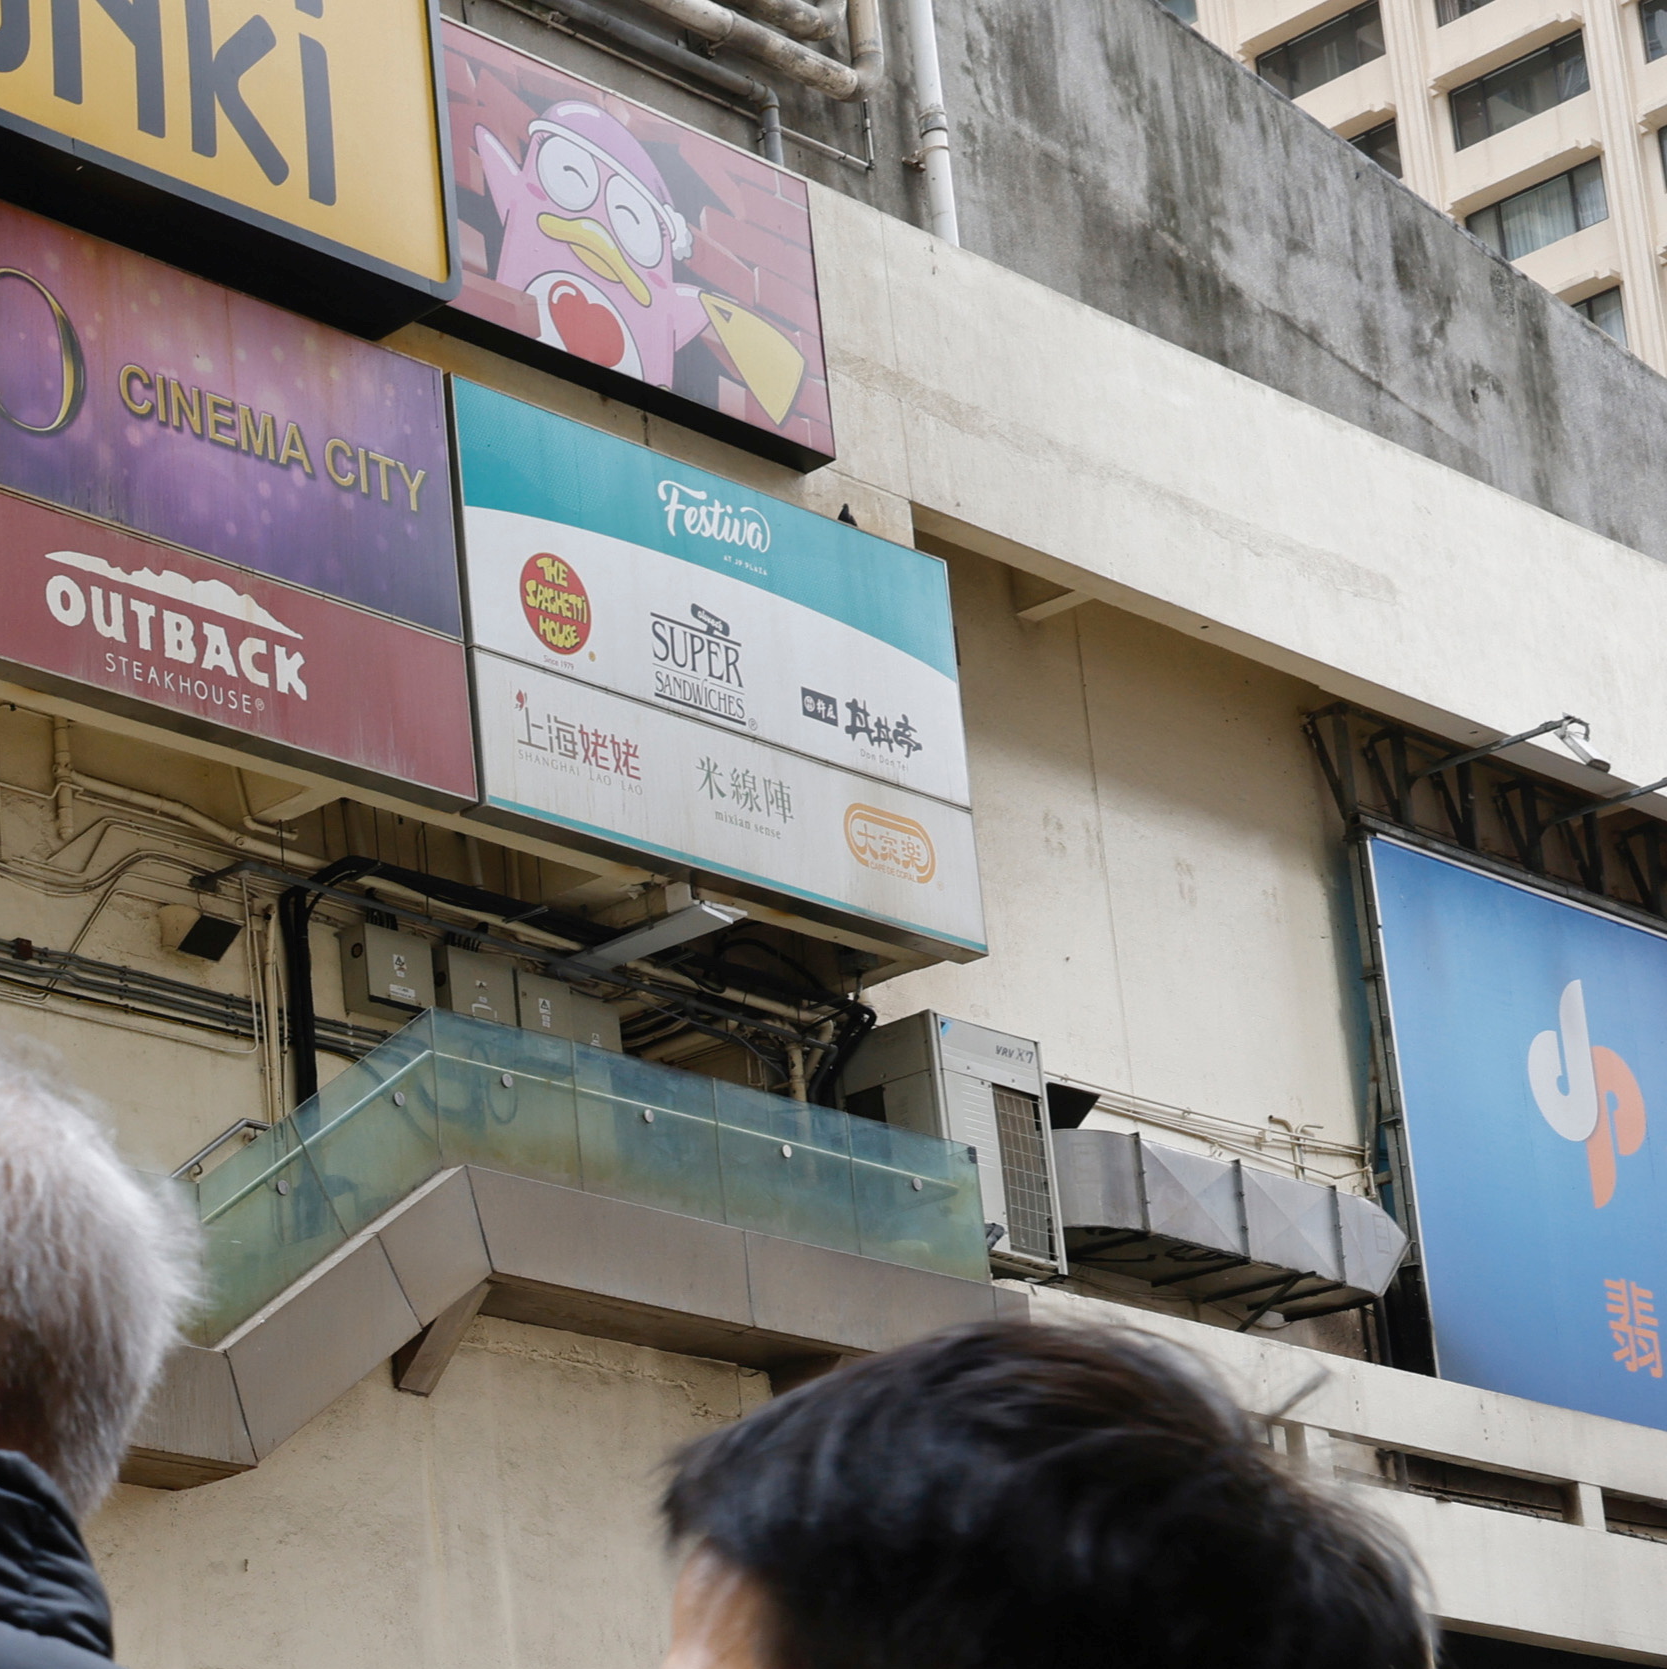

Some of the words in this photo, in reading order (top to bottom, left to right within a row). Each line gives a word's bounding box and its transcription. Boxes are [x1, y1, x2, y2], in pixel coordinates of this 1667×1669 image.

[118, 363, 315, 476] CINEMA
[323, 437, 427, 513] CITY
[657, 479, 771, 553] Festiva
[535, 557, 568, 588] THE
[44, 574, 308, 702] OUTBACK
[538, 615, 581, 649] HOUSE
[651, 620, 744, 688] SUPER
[104, 651, 254, 715] STEAKHOUSE
[543, 654, 561, 668] Since
[560, 660, 575, 671] 1979
[654, 670, 746, 719] SANDWICHES
[517, 706, 642, 781] 上海姥姥
[860, 748, 877, 761] Don
[879, 754, 896, 767] Don
[517, 750, 581, 777] SHANGHAI
[588, 770, 613, 787] LAO
[621, 780, 643, 796] LAO
[695, 755, 795, 826] 米線陣
[714, 809, 752, 832] mixian
[753, 820, 782, 841] sense
[995, 1045, 1016, 1058] VRV
